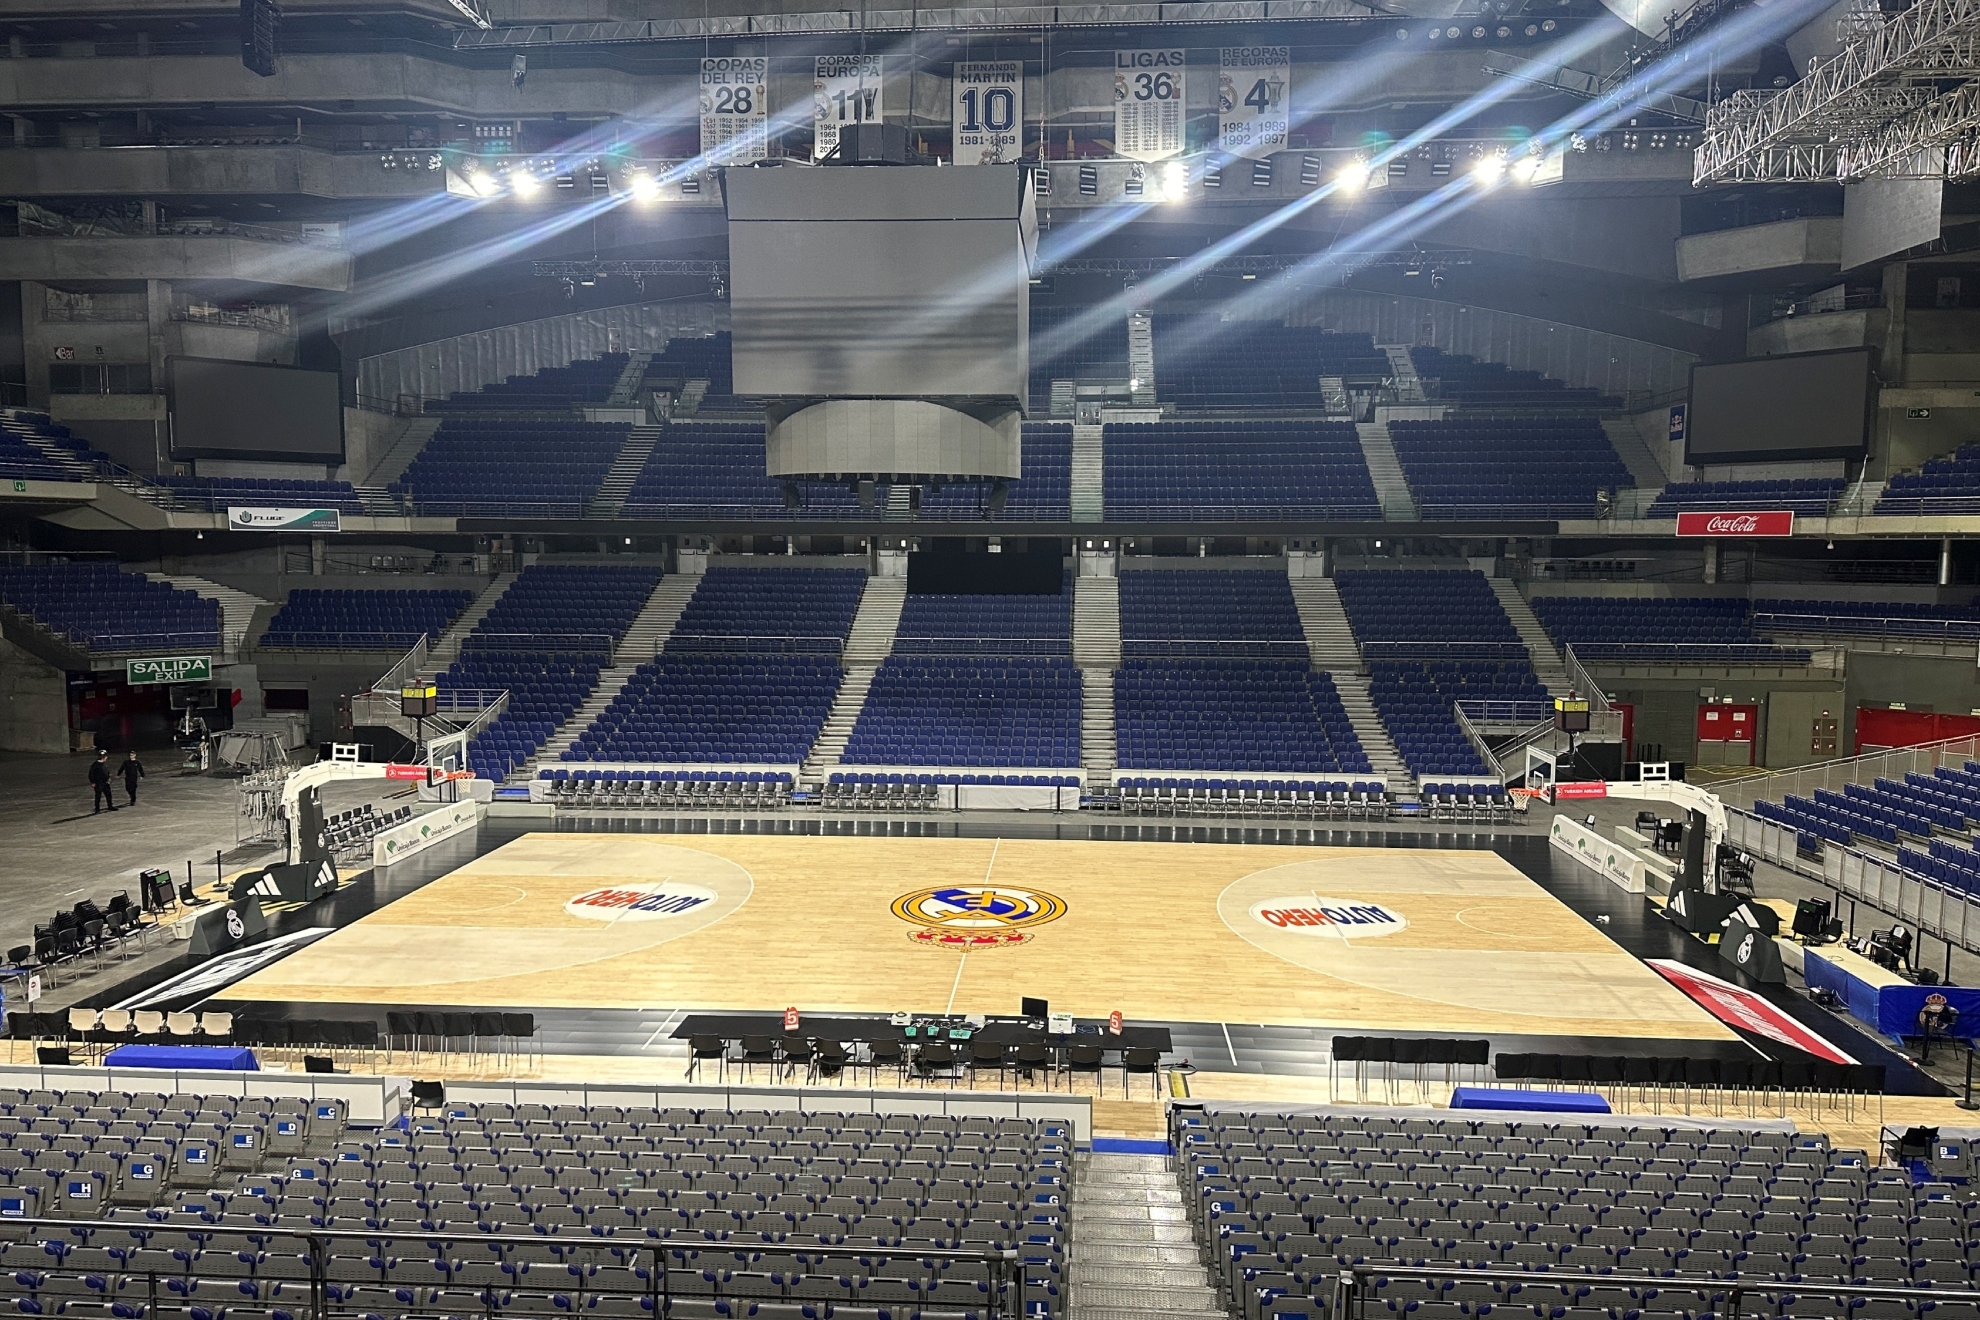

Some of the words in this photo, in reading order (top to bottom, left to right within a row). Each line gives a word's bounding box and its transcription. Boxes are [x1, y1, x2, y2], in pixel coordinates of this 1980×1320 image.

[1222, 47, 1288, 58] RECOPAS
[703, 59, 765, 71] COPAS
[818, 56, 860, 65] COPAS
[864, 56, 880, 64] DE
[1118, 51, 1183, 68] LIGAS
[1242, 57, 1288, 66] EUROPA
[817, 66, 879, 77] EUROPA
[960, 64, 1016, 72] FERNANDO
[702, 73, 730, 84] DEL
[735, 72, 764, 83] REY
[1134, 72, 1172, 100] 36
[715, 86, 752, 113] 28
[1245, 79, 1269, 114] 4
[832, 90, 862, 120] 11
[960, 87, 1016, 133] 10
[1223, 122, 1251, 132] 1984
[1258, 122, 1286, 132] 1989
[1223, 135, 1250, 145] 1992
[1258, 134, 1285, 144] 1997
[61, 348, 73, 359] Bar
[1707, 516, 1759, 532] Coca-Cola
[134, 660, 205, 673] SALIDA
[155, 671, 186, 681] EXIT
[788, 1011, 796, 1024] 5
[1111, 1015, 1119, 1028] 5
[1057, 1129, 1064, 1137] C
[199, 1150, 206, 1158] F
[144, 1165, 153, 1174] G
[81, 1184, 91, 1192] H
[20, 1200, 24, 1209] I
[1049, 1196, 1059, 1204] G
[1211, 1202, 1221, 1211] G
[1220, 1225, 1230, 1234] H
[1036, 1302, 1047, 1315] L
